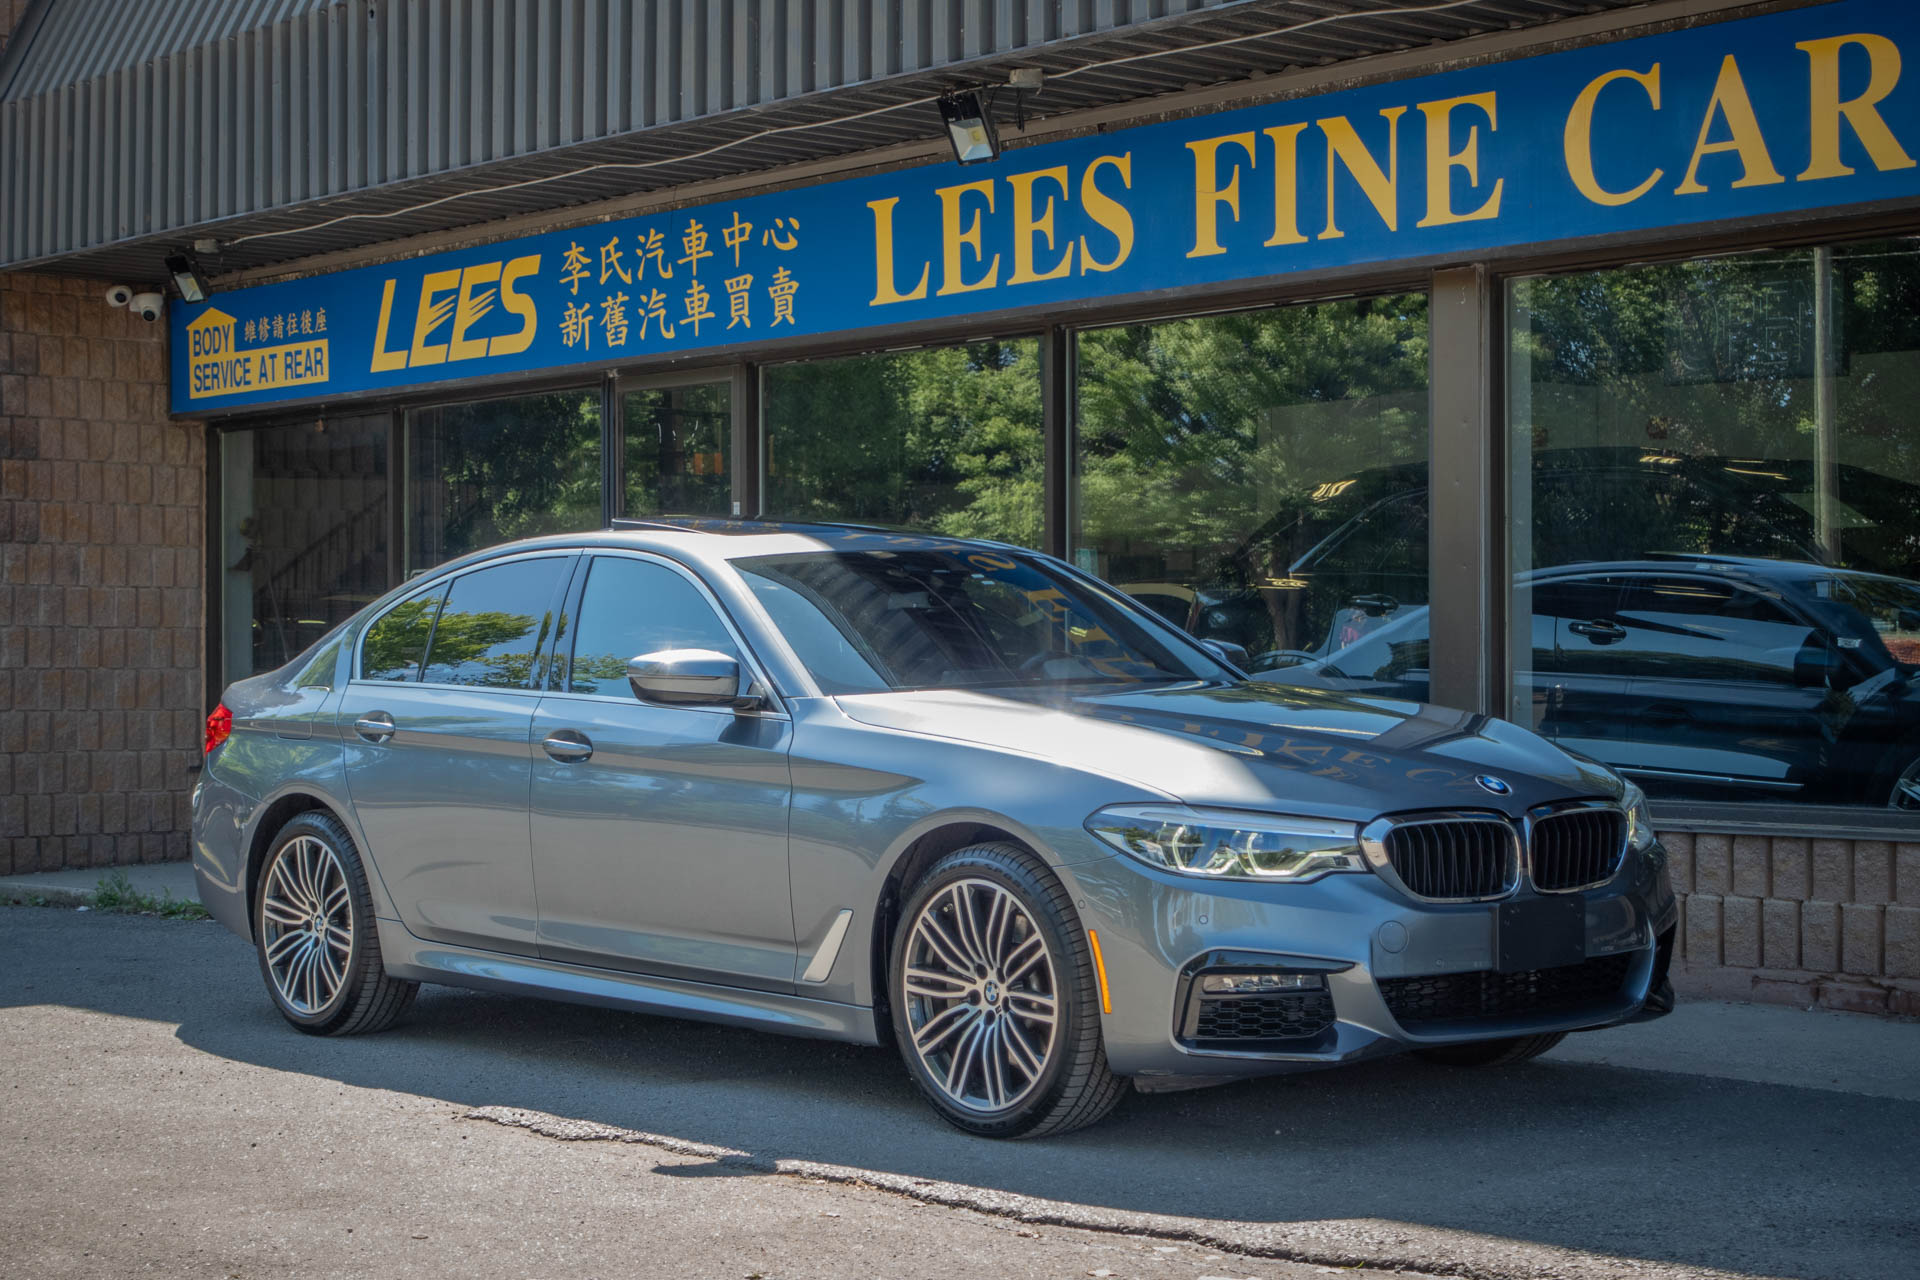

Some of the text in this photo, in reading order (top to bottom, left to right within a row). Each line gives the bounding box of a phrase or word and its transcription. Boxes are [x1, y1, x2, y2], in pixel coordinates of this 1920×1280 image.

[867, 32, 1917, 307] LEES FINE CAR
[559, 211, 800, 296] 李氏汽車中心
[192, 323, 231, 357] BODY
[370, 253, 541, 373] LEES
[559, 266, 800, 351] 新舊汽車買賣
[193, 346, 324, 393] SERVICE AT REAR
